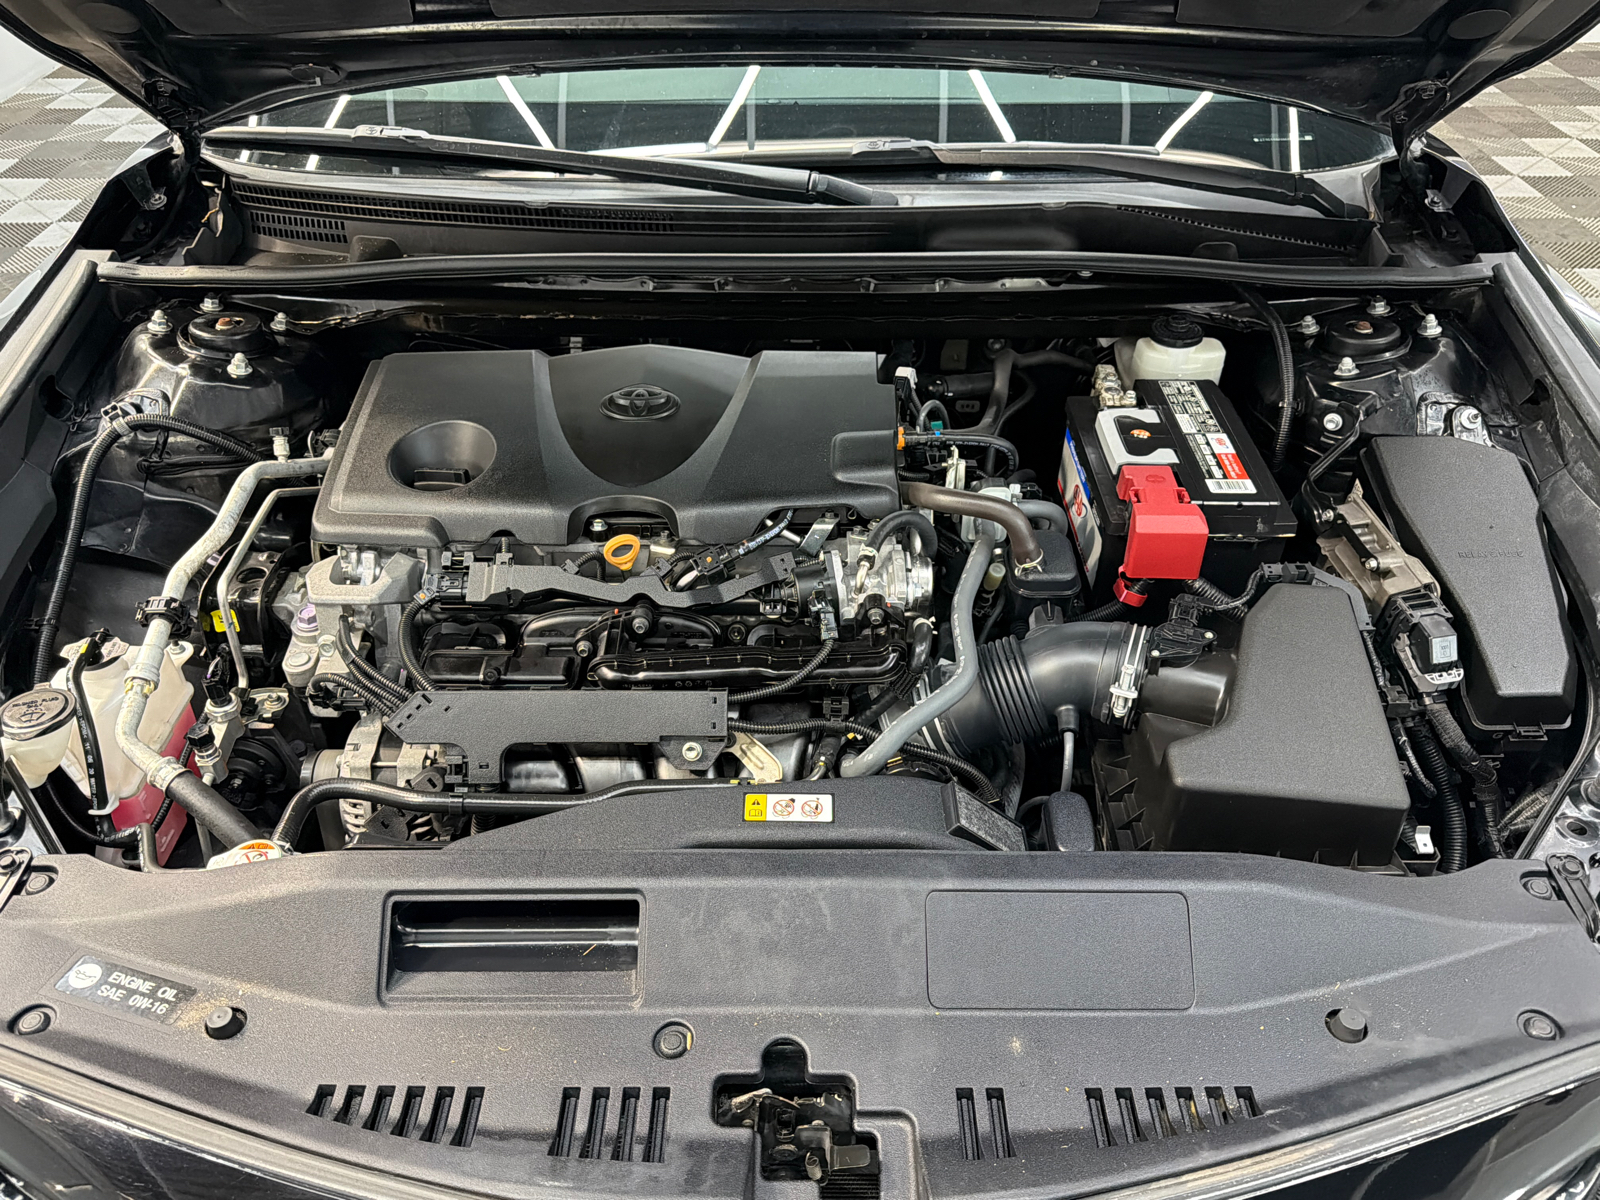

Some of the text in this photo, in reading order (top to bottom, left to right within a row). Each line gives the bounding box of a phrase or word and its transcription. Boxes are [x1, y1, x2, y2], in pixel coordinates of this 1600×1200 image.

[97, 984, 169, 1015] SAE 0W-16
[108, 971, 179, 1002] ENGINE OIL
